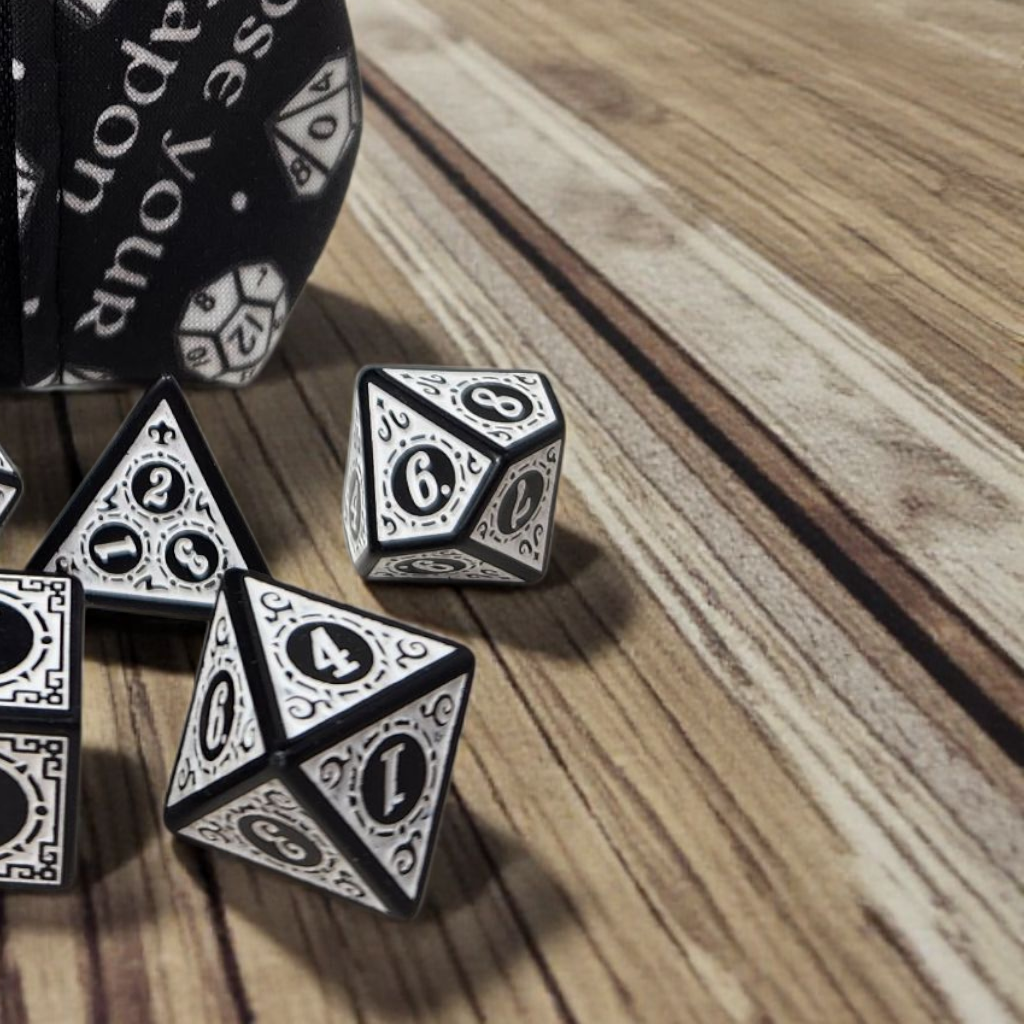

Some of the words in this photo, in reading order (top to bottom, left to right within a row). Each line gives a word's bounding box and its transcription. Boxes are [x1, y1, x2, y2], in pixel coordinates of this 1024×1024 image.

[308, 114, 336, 140] 0
[471, 387, 524, 418] 8
[143, 466, 173, 508] 2
[93, 534, 138, 564] 1
[173, 537, 209, 577] 3
[309, 626, 361, 679] 4
[379, 742, 407, 817] 1
